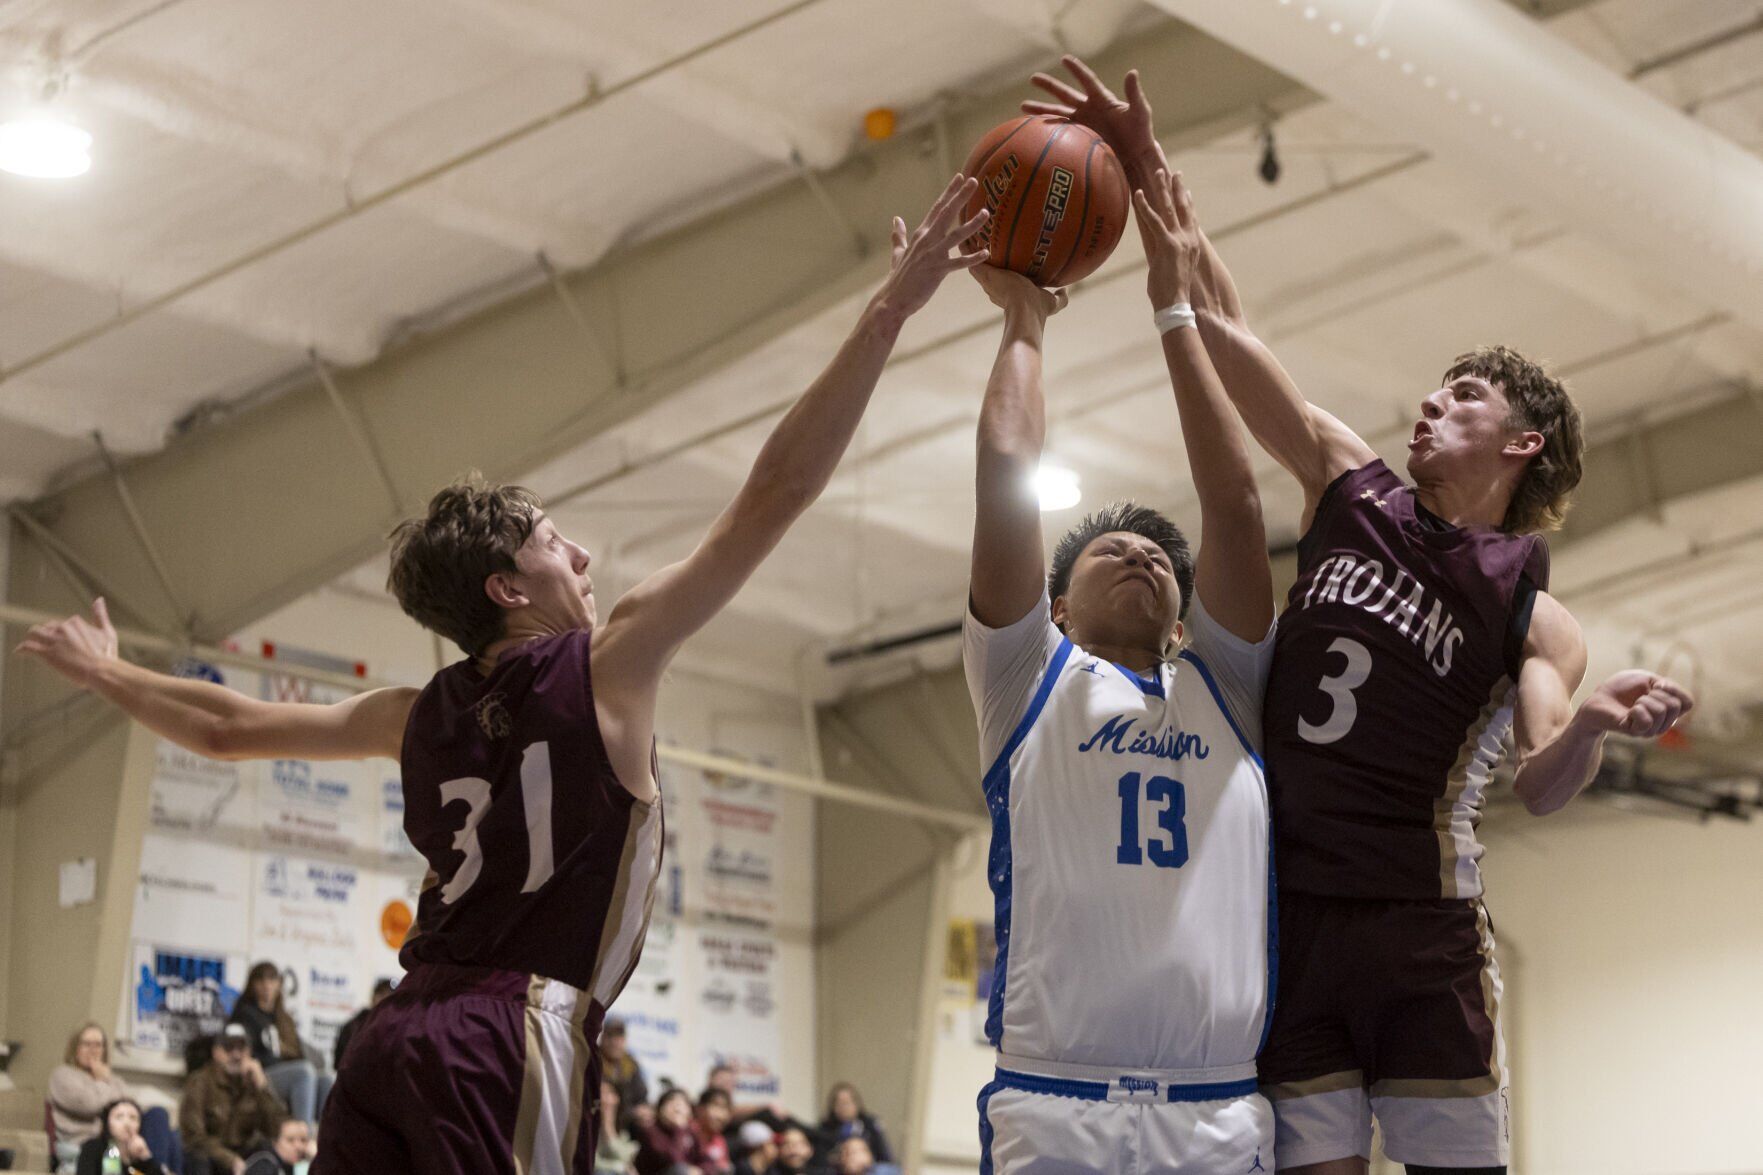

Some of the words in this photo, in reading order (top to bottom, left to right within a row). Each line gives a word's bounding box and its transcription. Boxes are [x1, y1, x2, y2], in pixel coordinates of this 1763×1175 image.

[1047, 168, 1073, 213] PRO
[1302, 554, 1465, 678] TROJANS
[1078, 713, 1210, 762] Mission
[1297, 636, 1373, 745] 3
[438, 740, 556, 905] 31
[1116, 771, 1190, 869] 13
